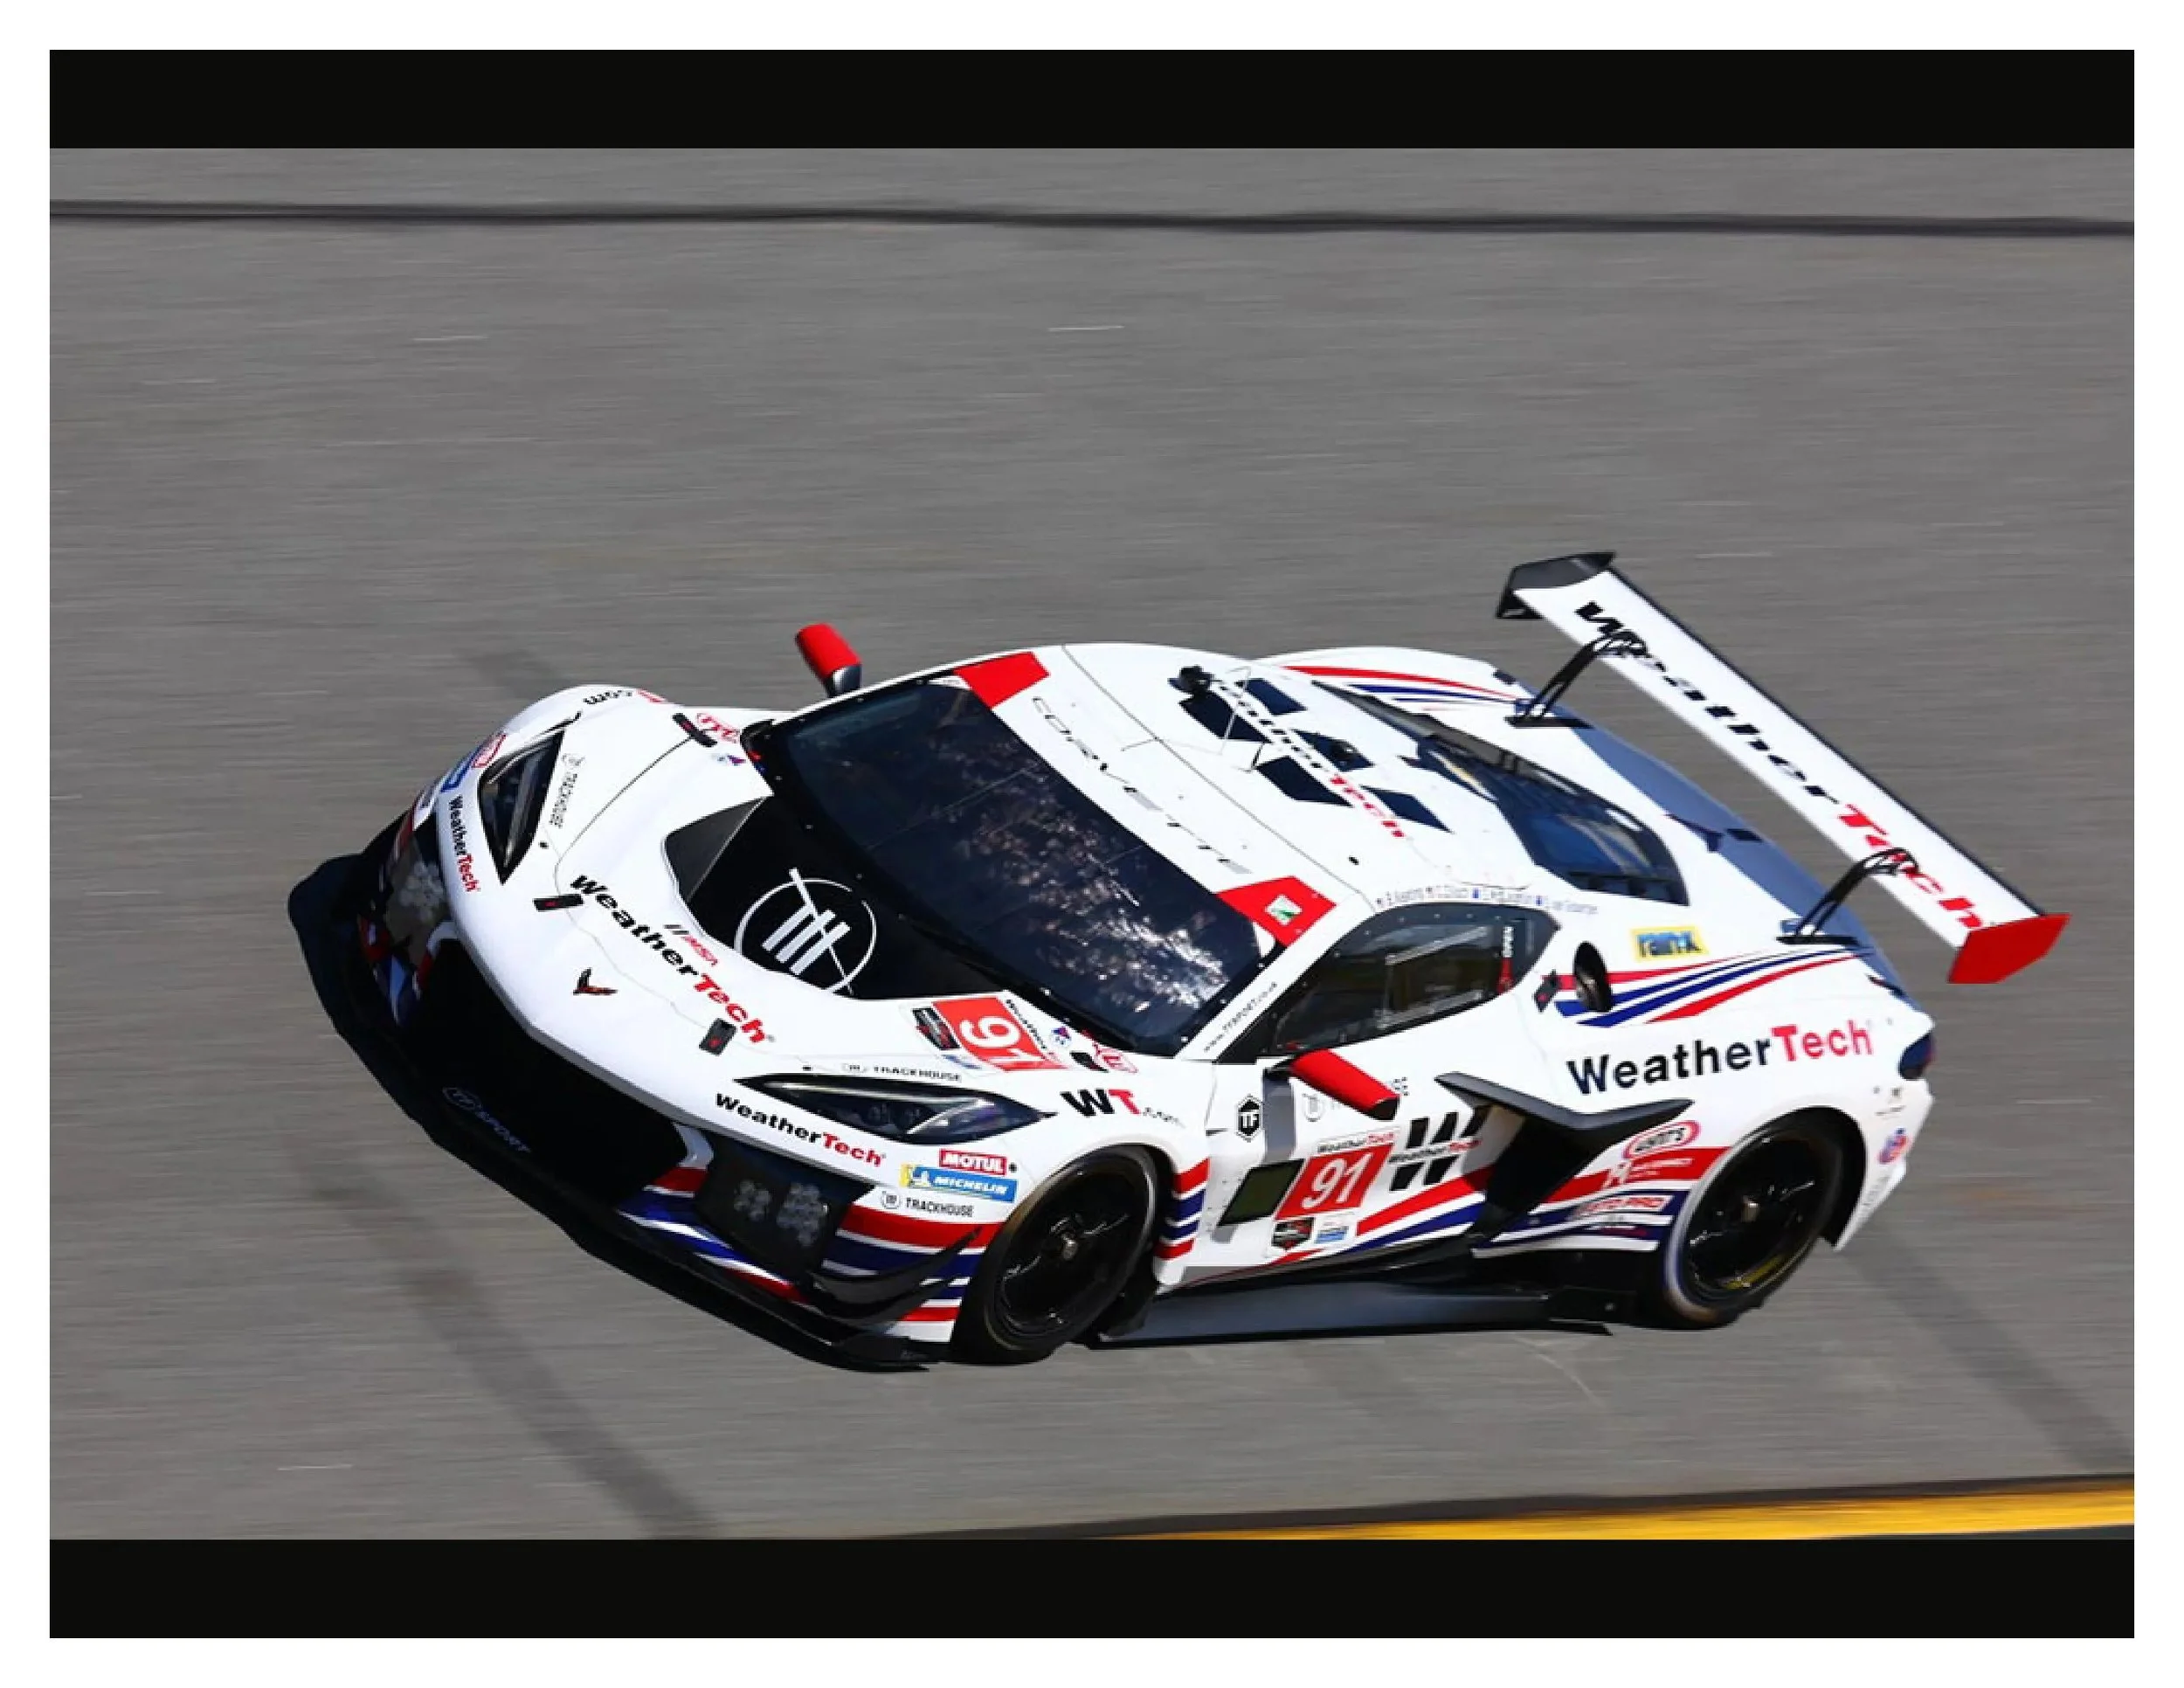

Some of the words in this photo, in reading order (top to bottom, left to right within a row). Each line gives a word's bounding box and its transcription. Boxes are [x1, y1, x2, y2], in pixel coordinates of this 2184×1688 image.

[449, 794, 480, 892] WeatherTech
[570, 875, 770, 1044] WeatherTech
[1566, 1020, 1872, 1096] WeatherTech
[715, 1092, 881, 1167] WeatherTech
[944, 1152, 1002, 1171] MOTUL
[906, 1196, 973, 1217] TRACKHOUSE
[933, 1175, 1007, 1195] MICHELIN
[1302, 1152, 1375, 1209] 91
